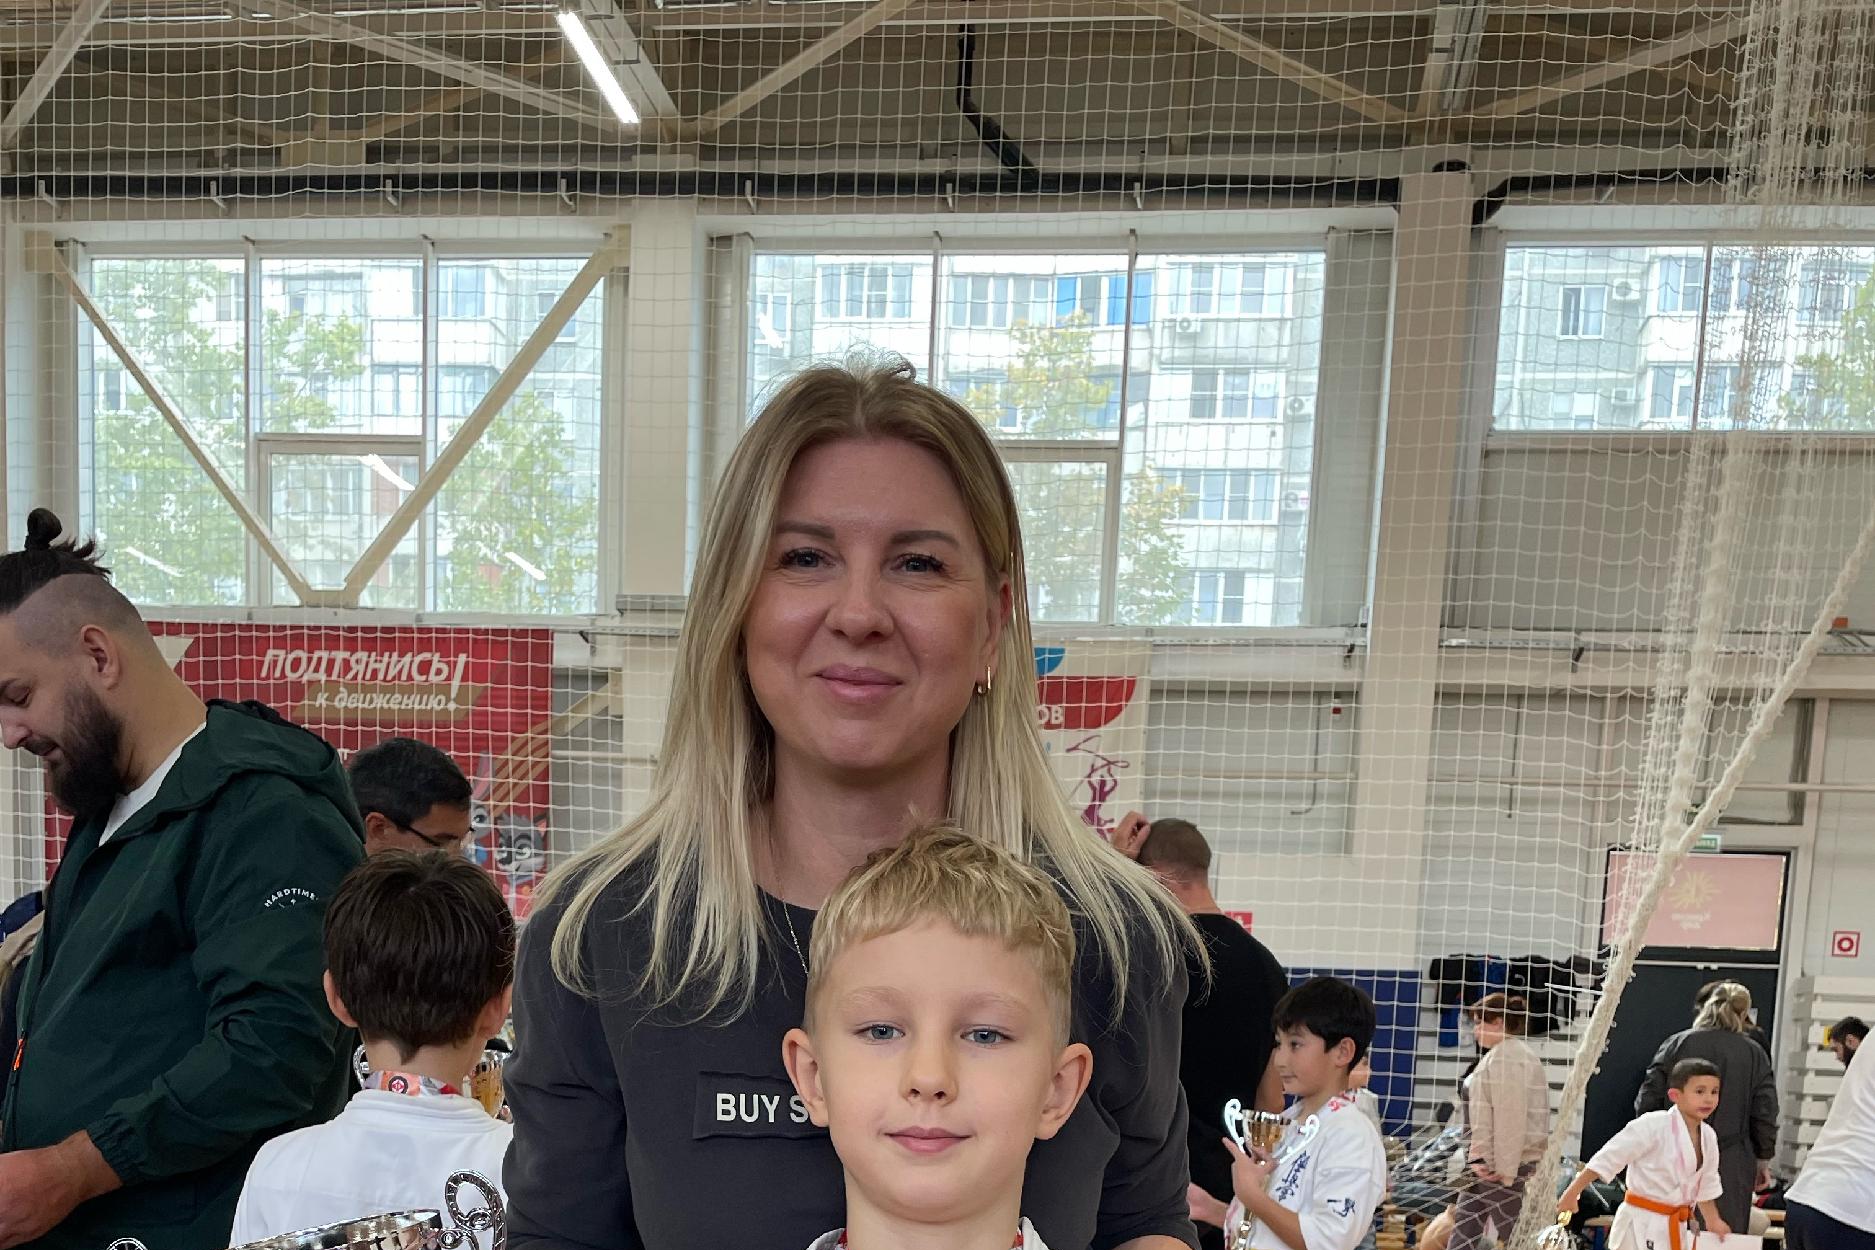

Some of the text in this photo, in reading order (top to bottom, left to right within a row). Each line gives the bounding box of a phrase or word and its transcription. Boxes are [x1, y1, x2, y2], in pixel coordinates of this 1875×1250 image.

[315, 688, 447, 711] к движению
[716, 1093, 780, 1123] BUY
